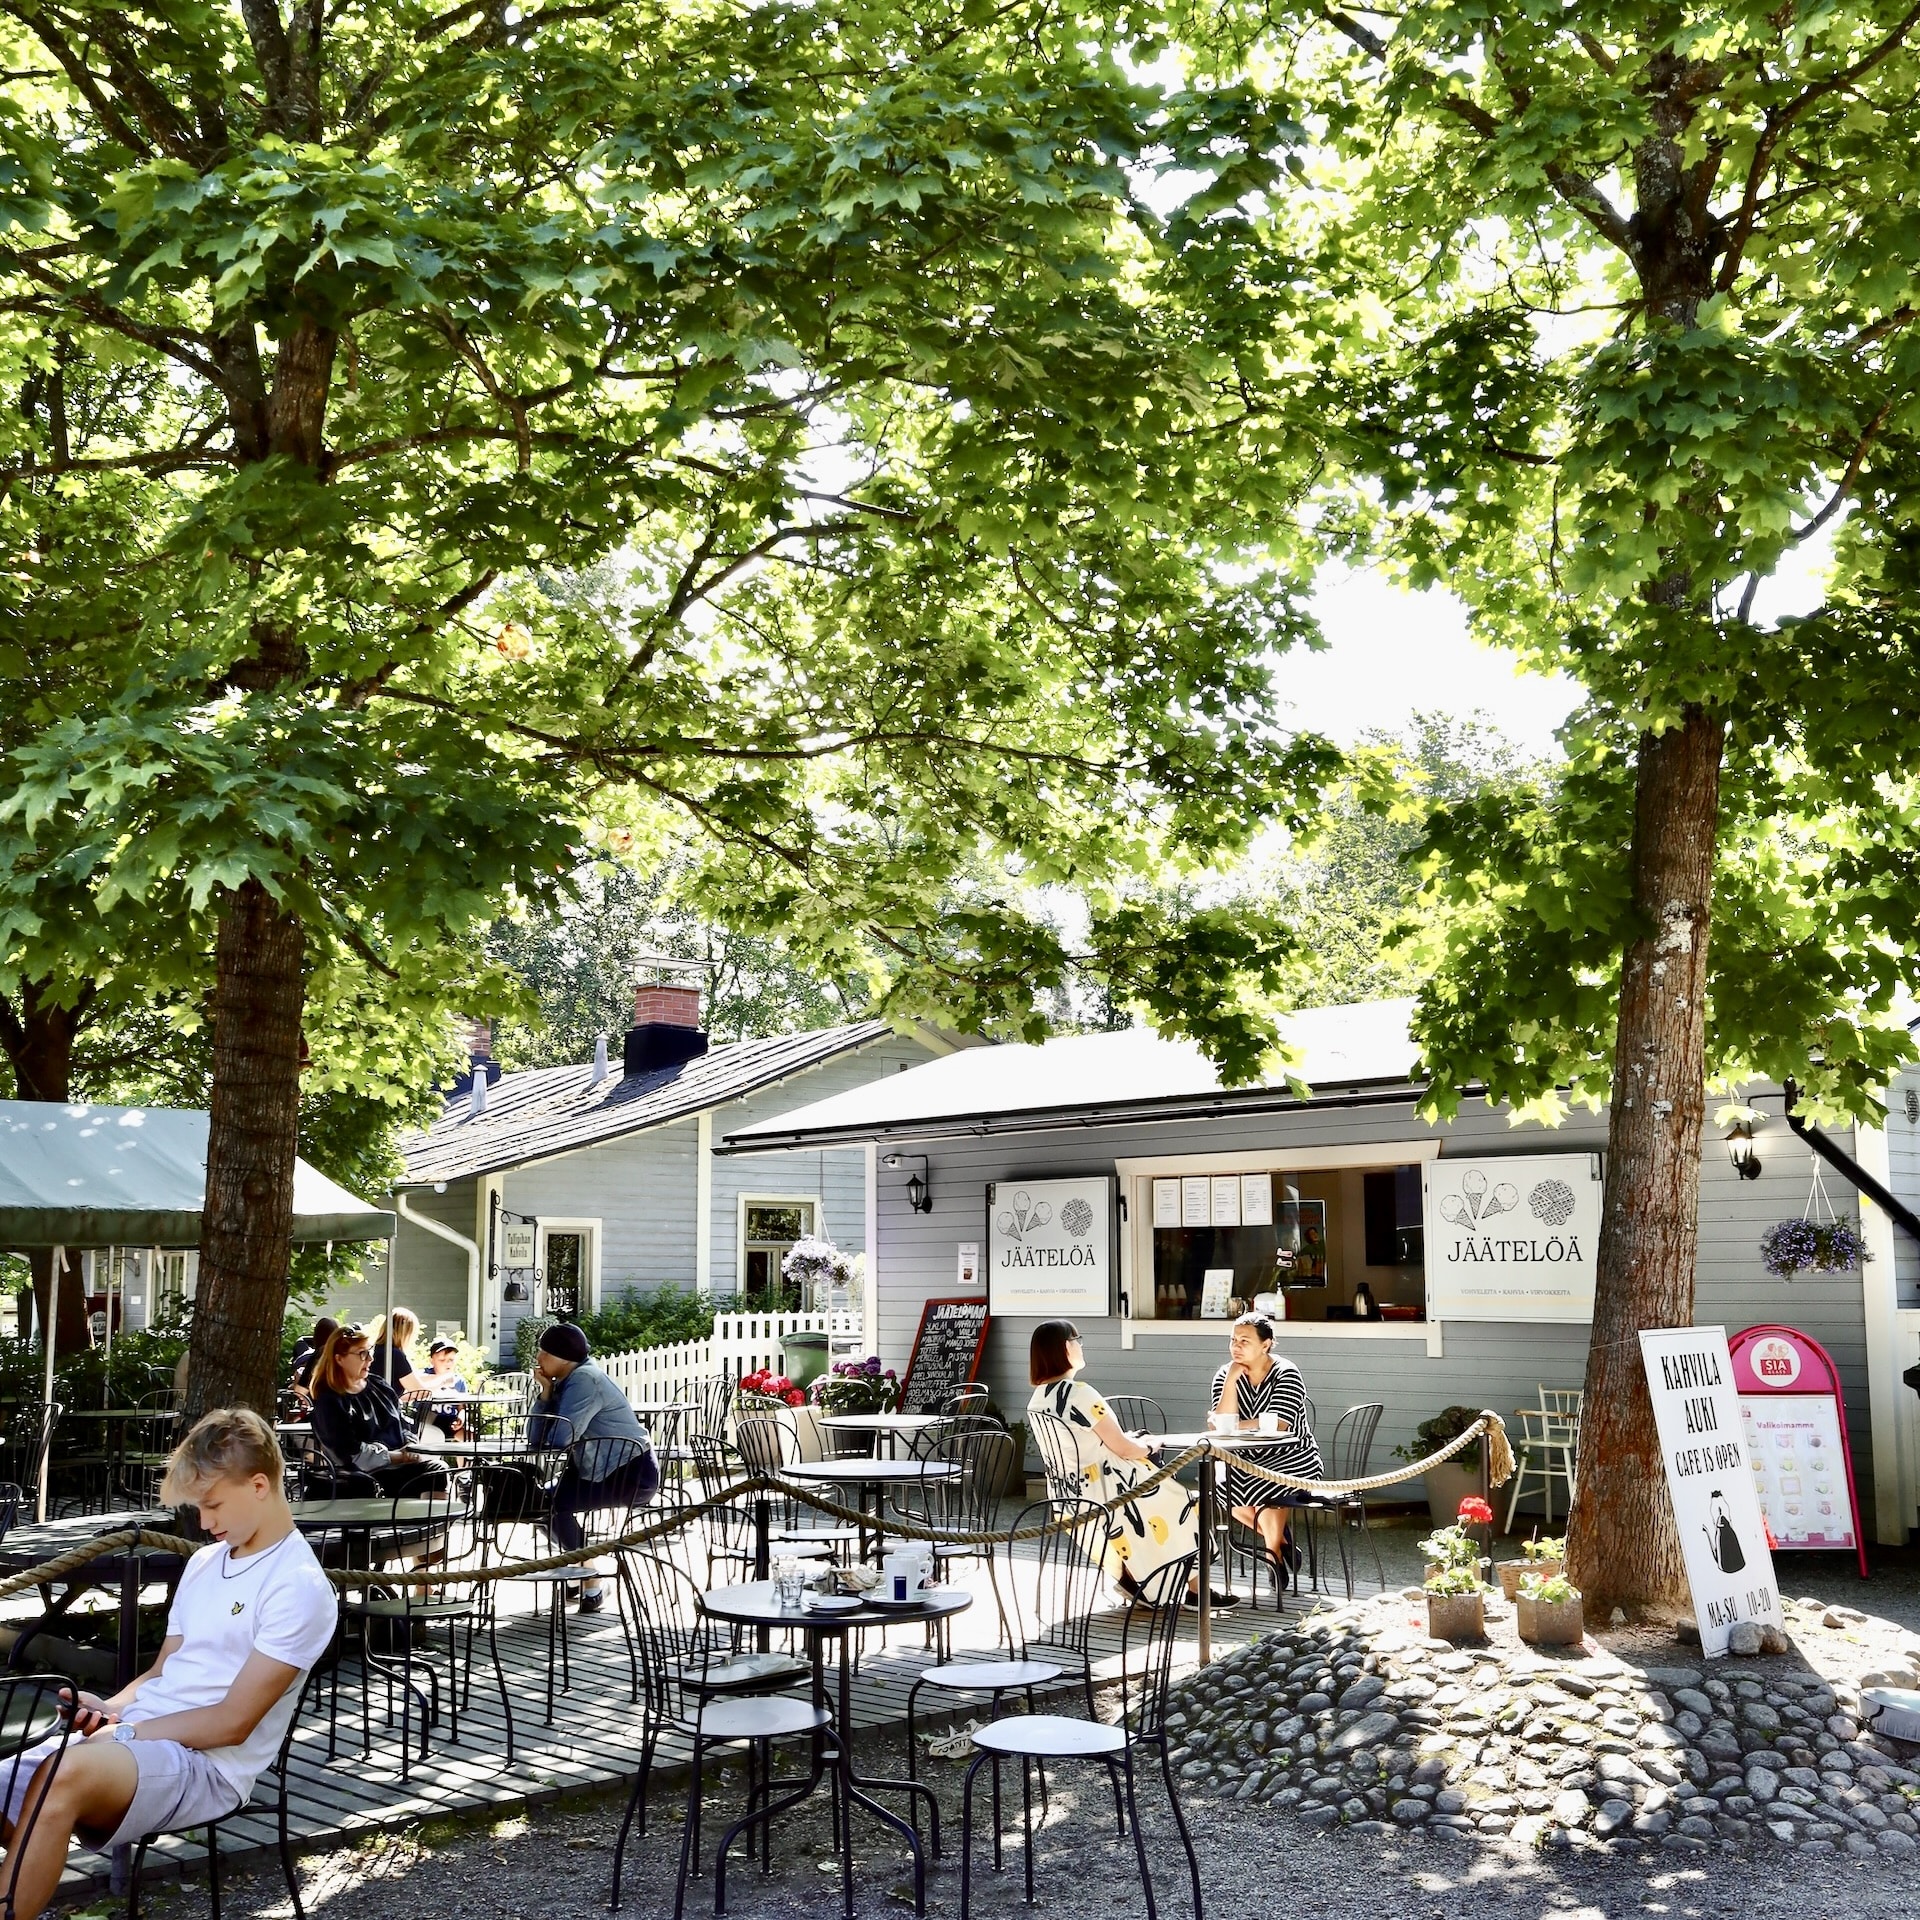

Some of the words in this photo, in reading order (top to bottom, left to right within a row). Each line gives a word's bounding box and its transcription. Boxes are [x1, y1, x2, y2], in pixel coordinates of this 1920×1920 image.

[1001, 1244, 1096, 1268] JÄÄTELÖÄ
[1447, 1235, 1583, 1262] JÄÄTELÖÄ
[1660, 1352, 1722, 1390] KAHVILA
[1765, 1360, 1787, 1371] SIA
[1684, 1396, 1718, 1434] AUKI
[1756, 1421, 1814, 1429] Valikoimamme
[1675, 1448, 1702, 1477] CAFE
[1702, 1447, 1714, 1472] IS
[1715, 1442, 1741, 1470] OPEN
[1706, 1596, 1738, 1628] MA-SU
[1746, 1587, 1772, 1616] 10-20
